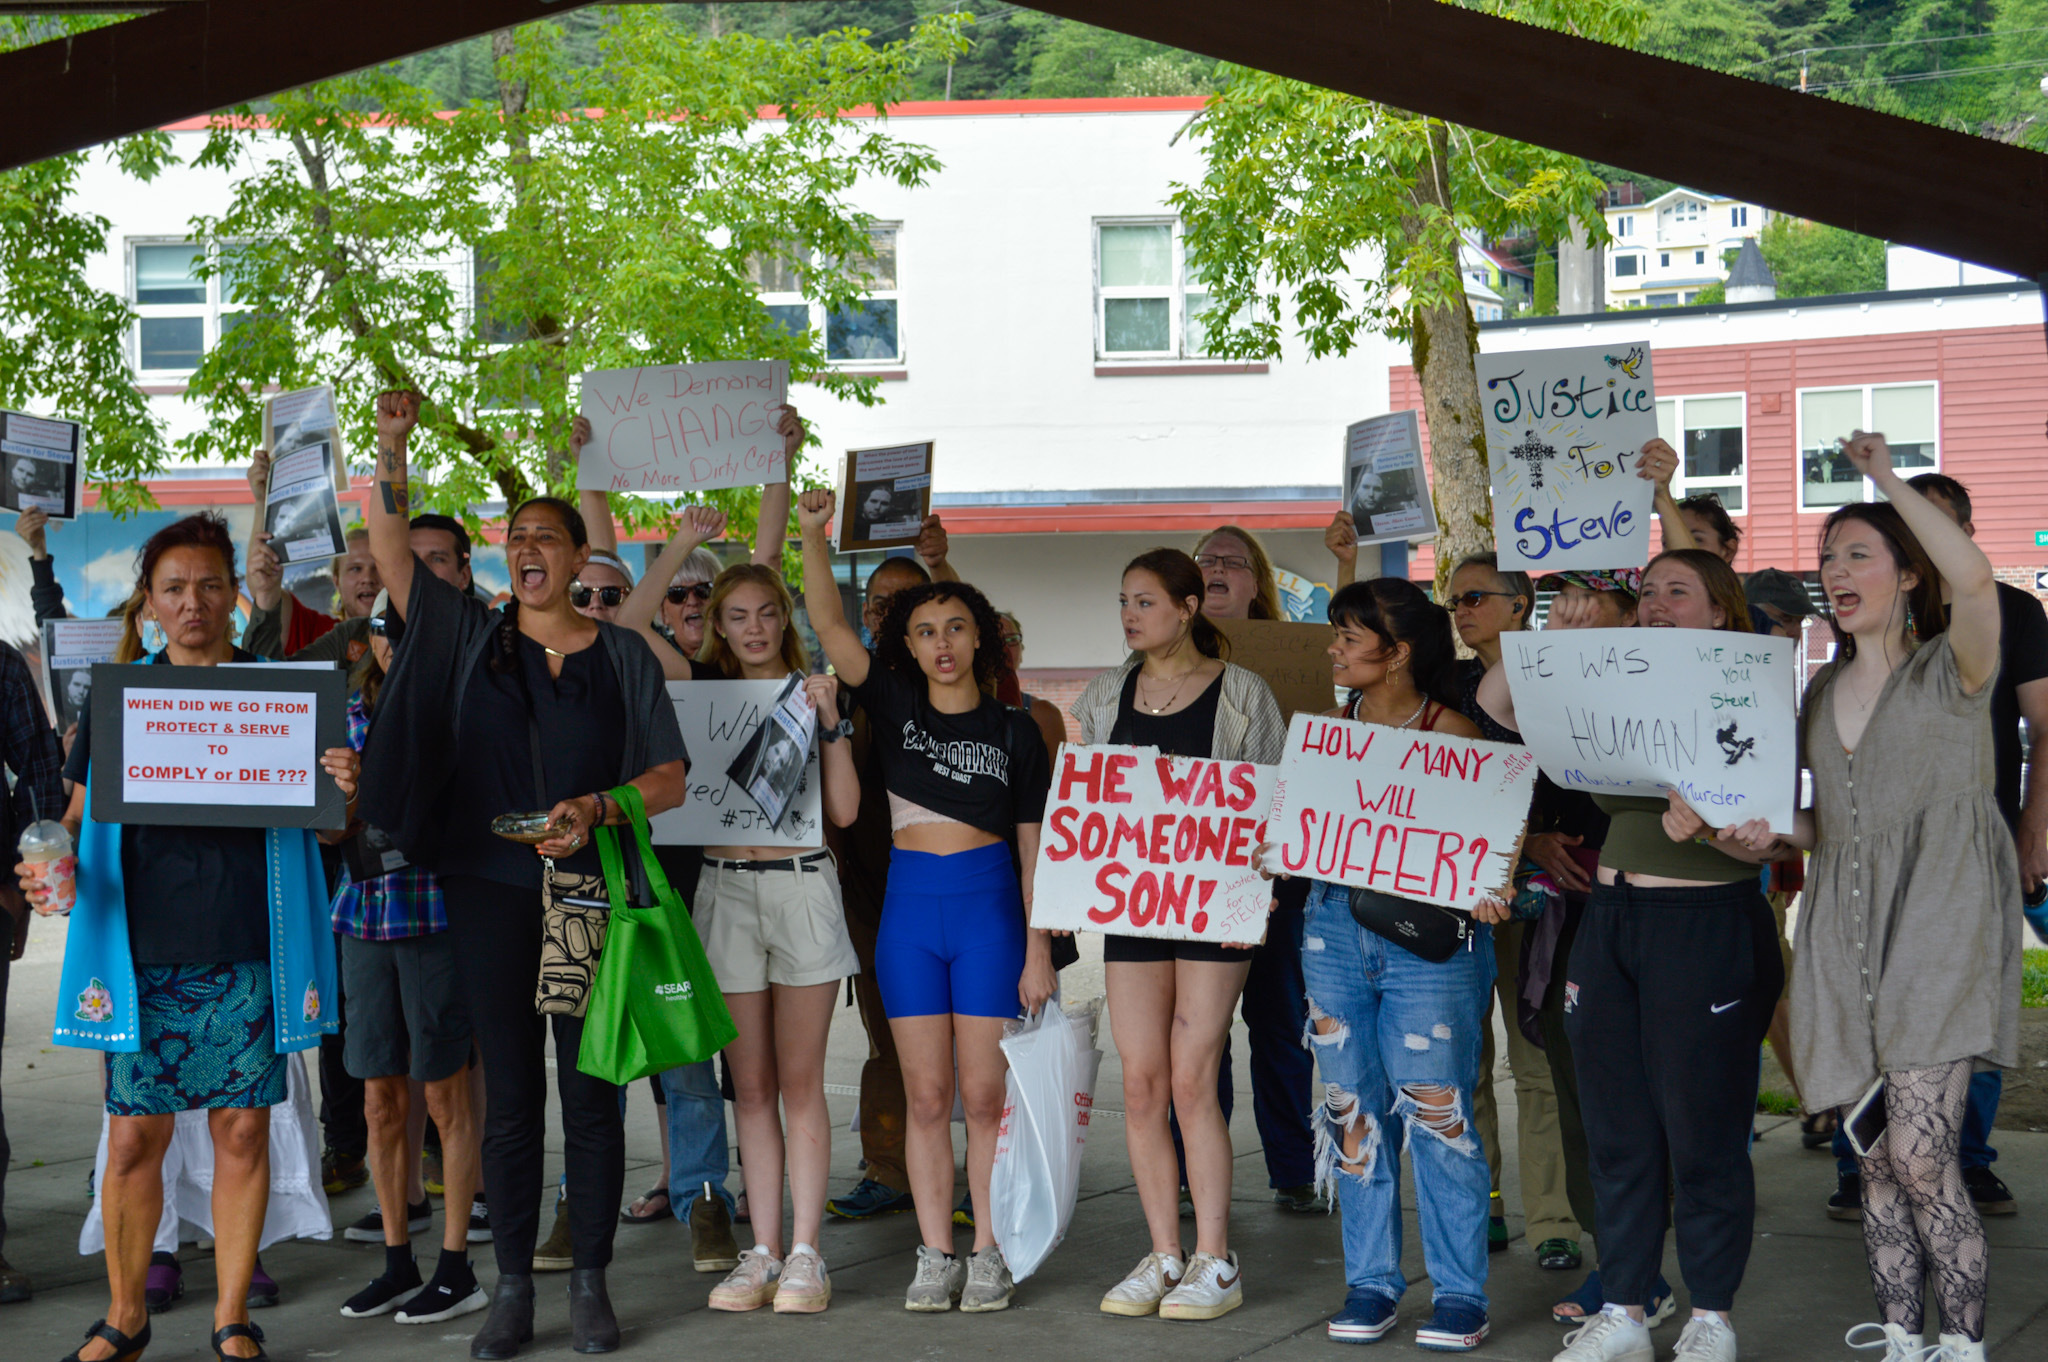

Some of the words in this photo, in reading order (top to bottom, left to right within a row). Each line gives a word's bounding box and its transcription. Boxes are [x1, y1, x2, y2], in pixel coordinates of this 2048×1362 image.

[593, 367, 651, 415] We
[660, 365, 772, 399] Demand
[33, 448, 45, 458] for
[610, 473, 630, 490] No
[641, 470, 682, 488] More
[690, 453, 739, 483] Dirty
[744, 445, 786, 474] Cops
[1568, 441, 1634, 479] For
[1514, 500, 1636, 560] Steve
[1276, 572, 1302, 592] LL
[1518, 643, 1553, 681] HE
[1580, 646, 1650, 679] WAS
[1696, 647, 1724, 664] WE
[1734, 652, 1772, 665] LOVE
[1722, 668, 1752, 685] YOU
[127, 699, 174, 711] WHEN
[178, 700, 205, 712] DID
[210, 701, 234, 712] WE
[238, 702, 260, 713] GO
[265, 702, 309, 714] FROM
[146, 721, 218, 734] PROTECT
[224, 724, 234, 734] &
[240, 724, 290, 736] SERVE
[1566, 706, 1698, 772] HUMAN
[208, 744, 228, 756] TO
[1302, 721, 1375, 762] HOW
[1399, 740, 1494, 782] MANY
[1503, 754, 1518, 768] RIP
[128, 766, 208, 780] COMPLY
[214, 768, 233, 781] or
[239, 768, 270, 782] DIE
[276, 770, 308, 782] ???
[932, 762, 950, 778] WEST
[951, 770, 972, 784] COAST
[1058, 752, 1138, 804] HE
[1155, 757, 1257, 812] WAS
[1356, 779, 1416, 820] WILL
[1677, 779, 1746, 806] Murder
[1282, 808, 1489, 901] SUFFER?
[1087, 861, 1218, 934] SON!
[1222, 872, 1258, 894] Justice
[1220, 892, 1268, 936] STEVE
[1226, 894, 1244, 910] for
[664, 980, 692, 994] SEAR
